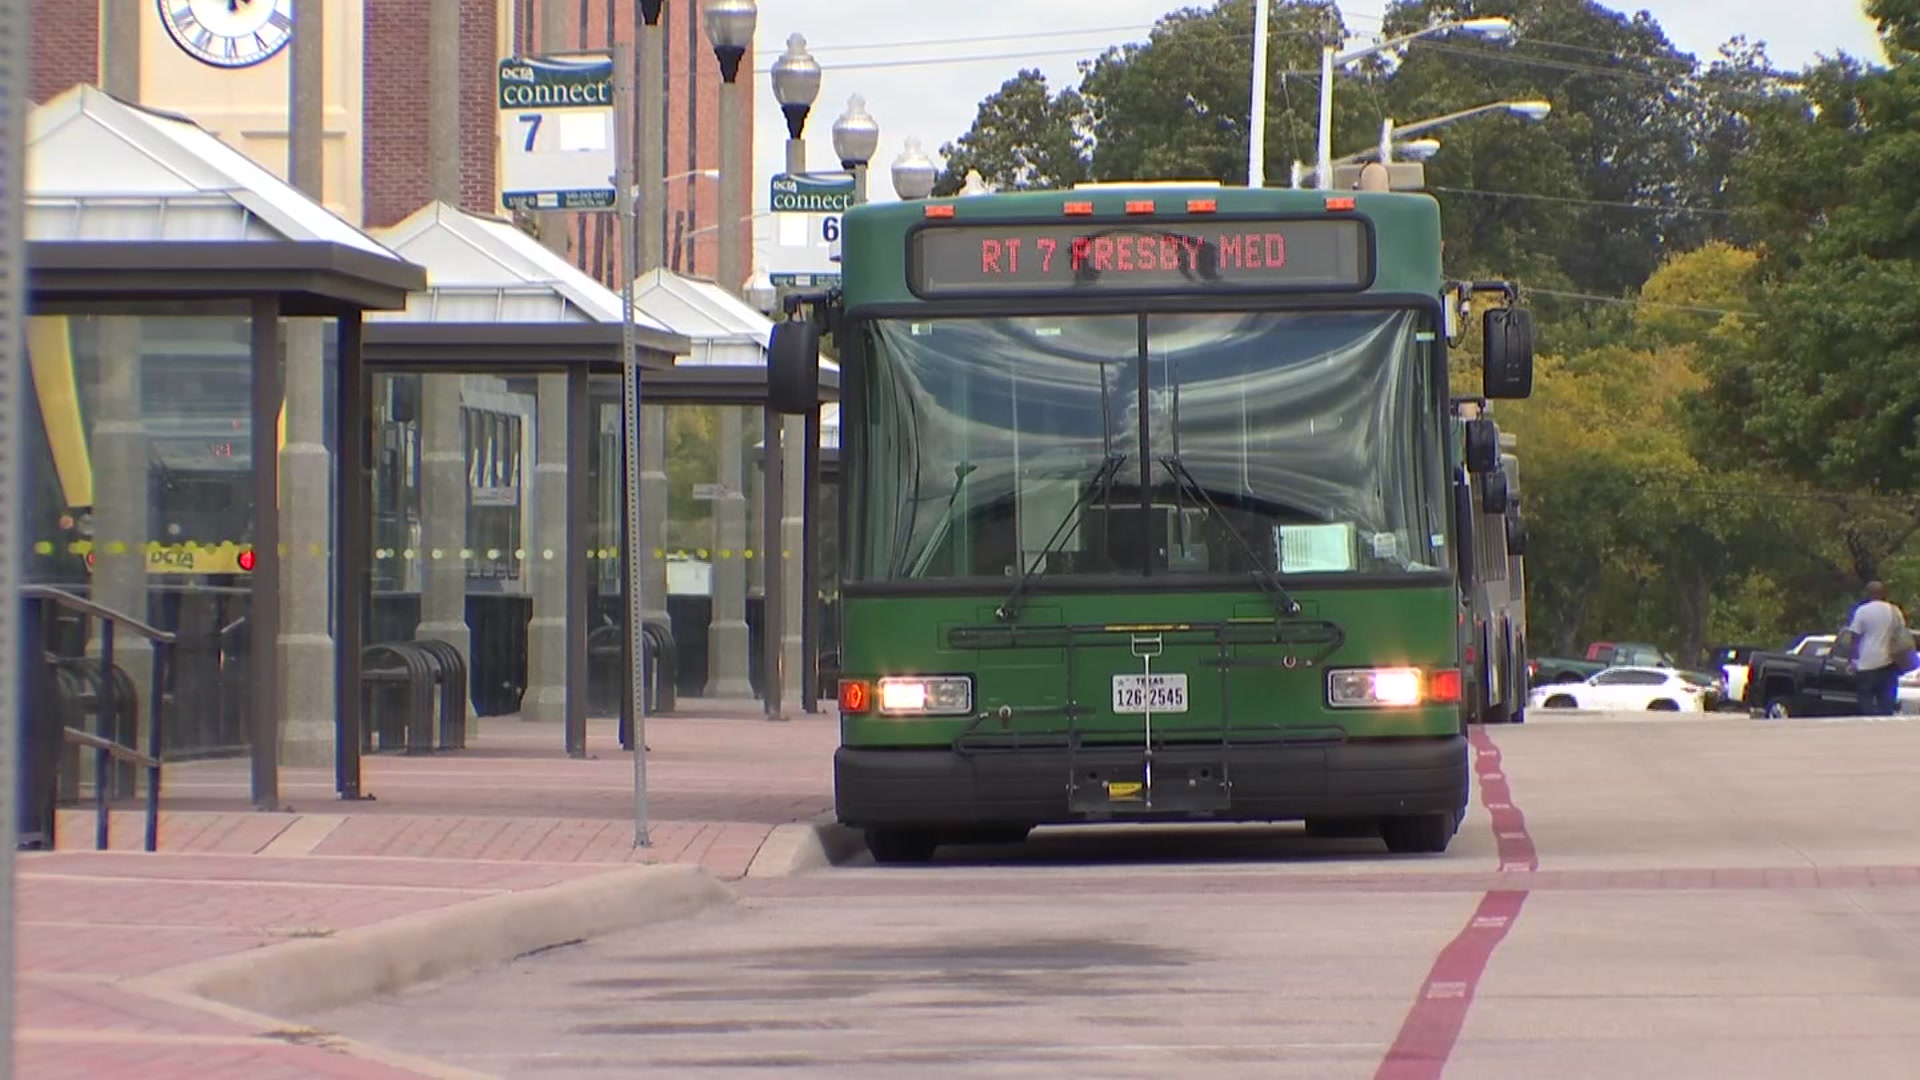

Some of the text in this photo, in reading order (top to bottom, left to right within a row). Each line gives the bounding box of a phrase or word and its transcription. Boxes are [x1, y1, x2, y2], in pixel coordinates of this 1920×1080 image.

[502, 67, 534, 82] DCTA
[503, 82, 607, 105] connect
[518, 114, 543, 152] 7
[773, 193, 850, 209] connect
[822, 216, 840, 243] 6
[981, 233, 1286, 273] RT 7 PRESBY MED
[150, 551, 194, 569] DCTA
[1136, 676, 1165, 687] TEXAS
